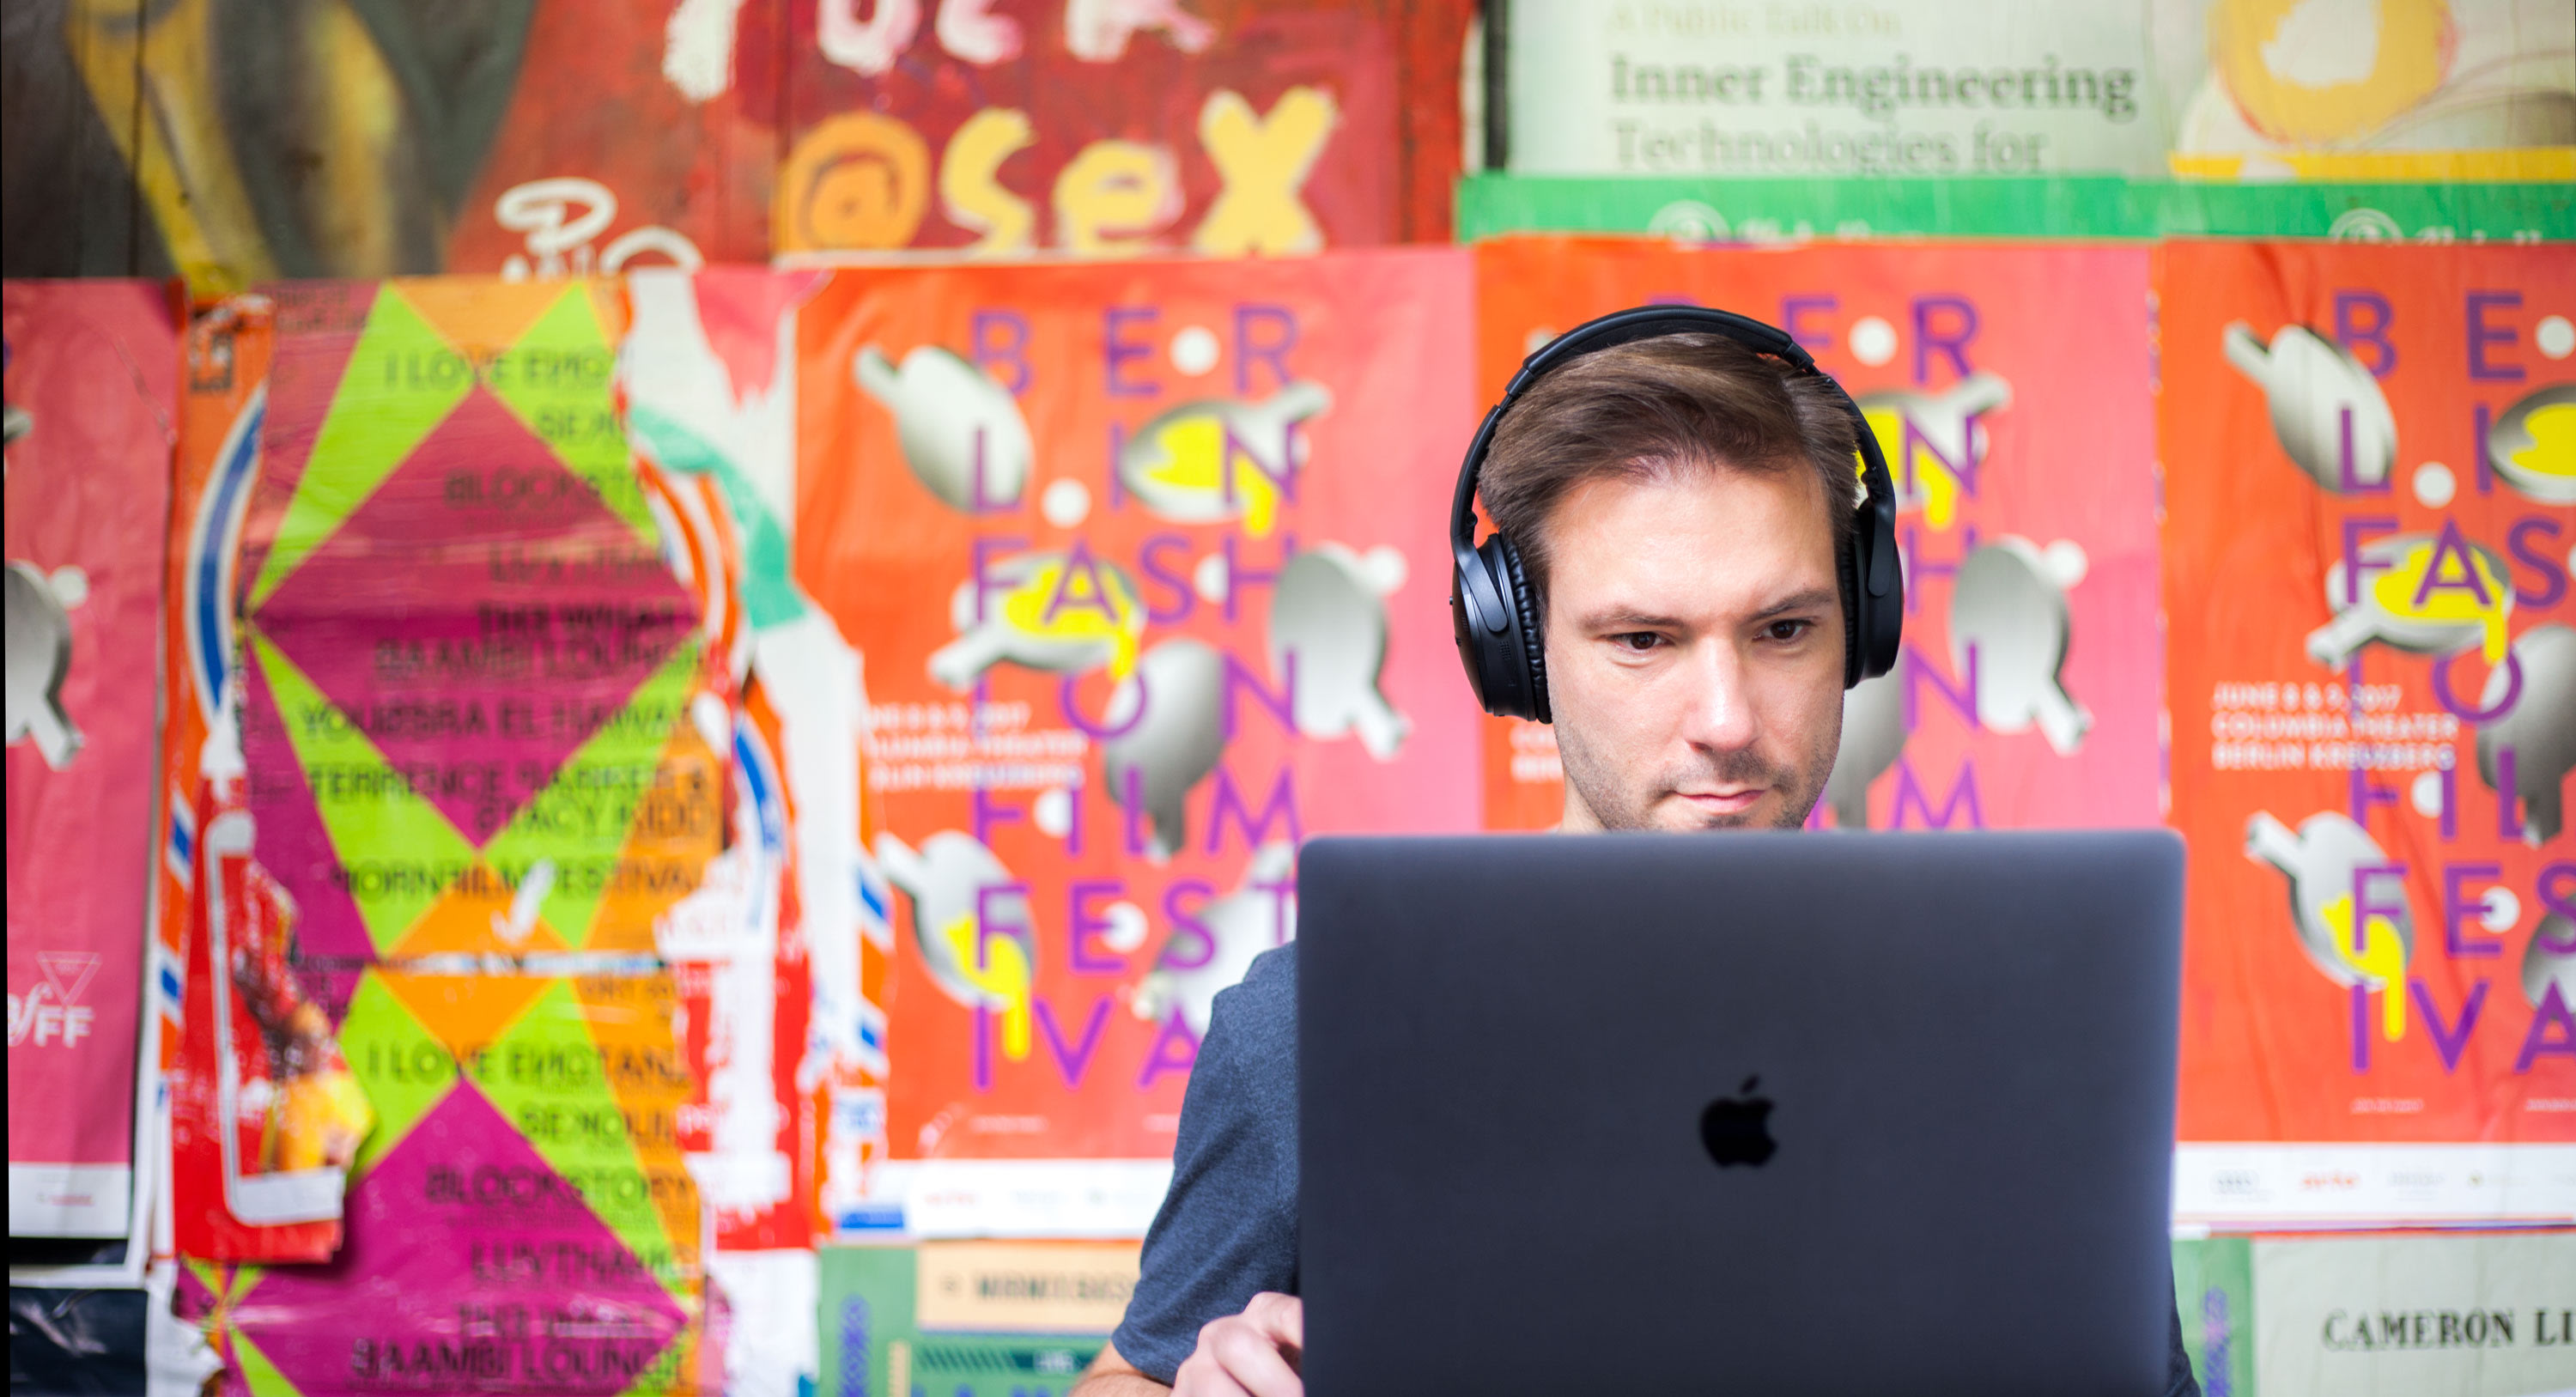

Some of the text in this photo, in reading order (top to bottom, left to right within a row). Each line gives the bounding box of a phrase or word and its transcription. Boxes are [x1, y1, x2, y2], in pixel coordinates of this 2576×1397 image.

[1611, 55, 2139, 122] Inner Engineering
[1613, 118, 2048, 174] Technologies for
[971, 307, 1300, 398] BER
[2211, 742, 2306, 770] BERLIN
[2321, 1308, 2516, 1351] CAMERON
